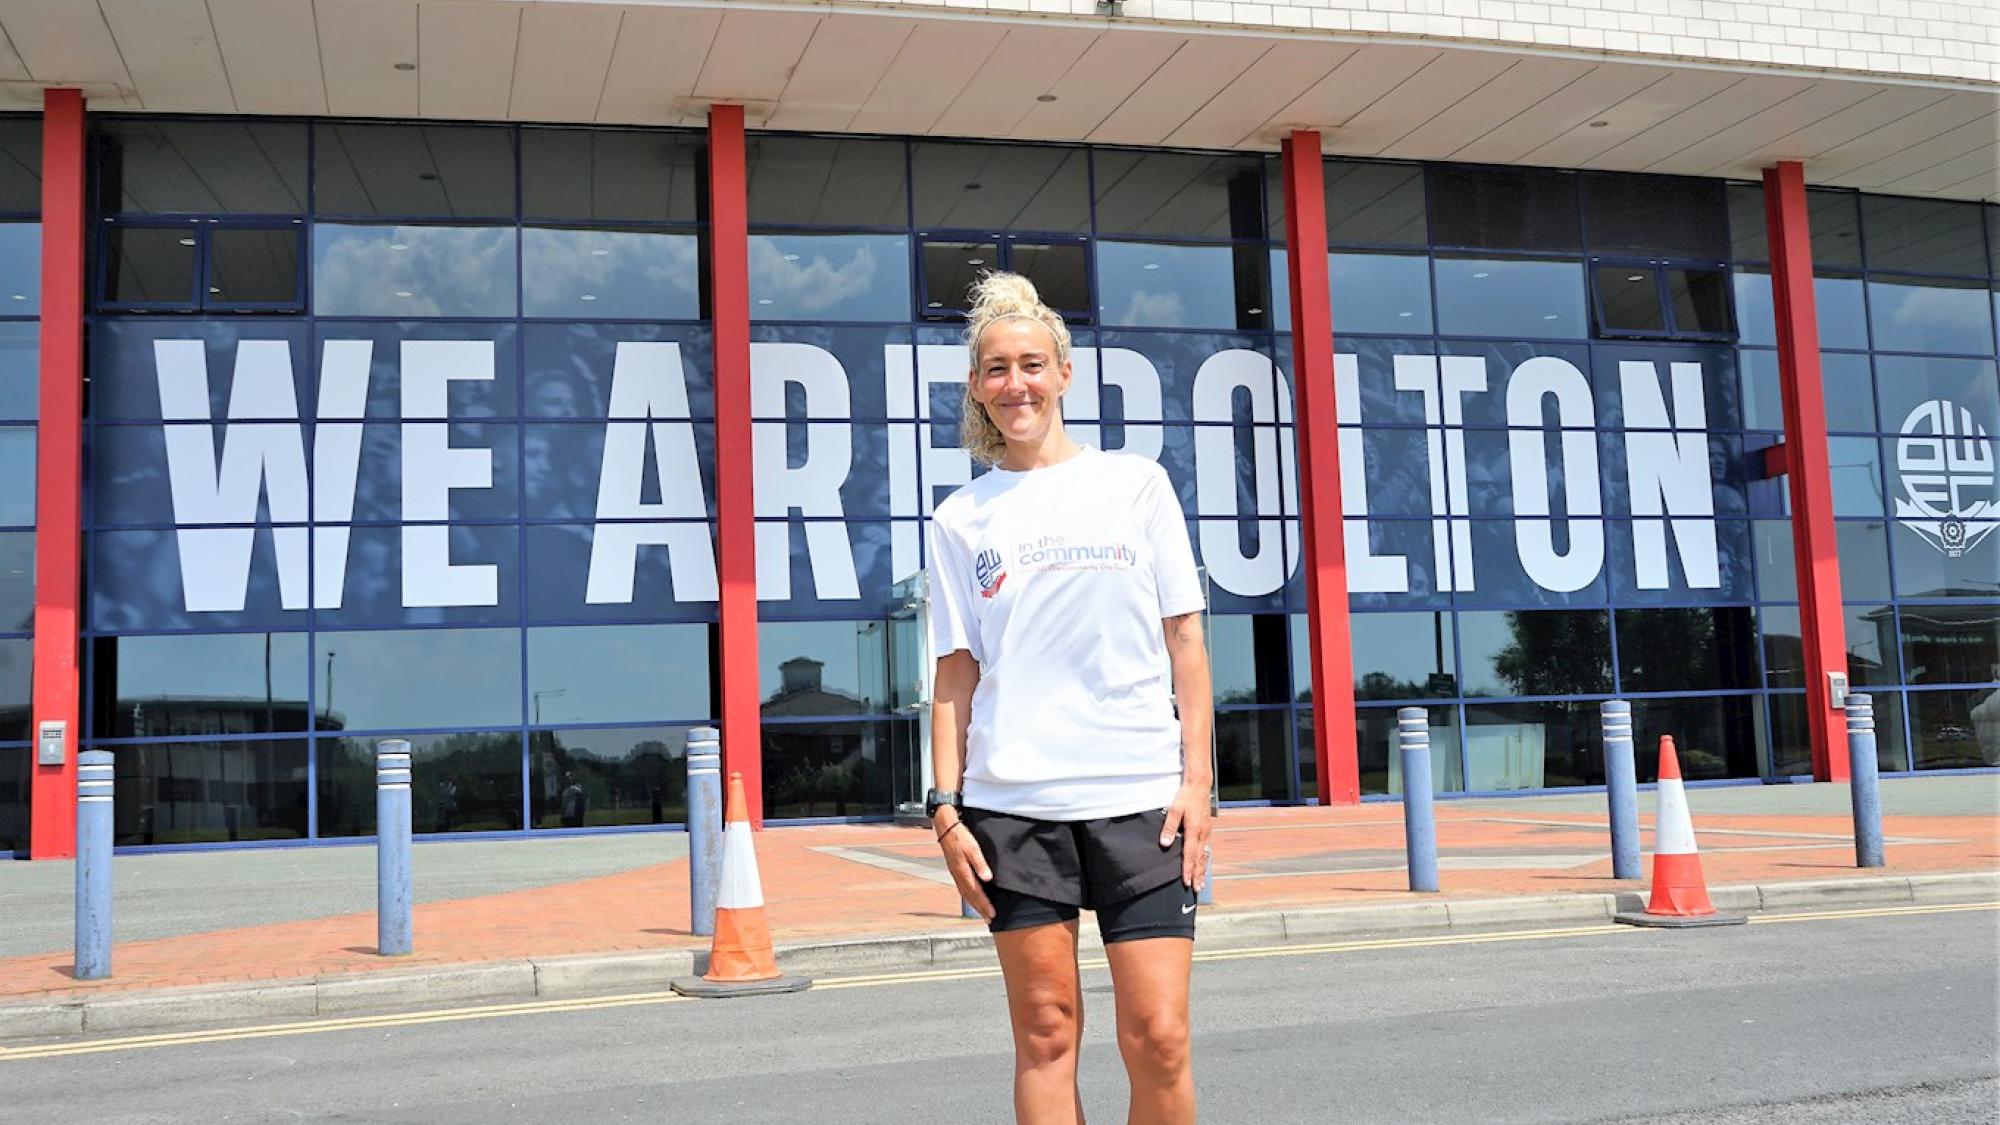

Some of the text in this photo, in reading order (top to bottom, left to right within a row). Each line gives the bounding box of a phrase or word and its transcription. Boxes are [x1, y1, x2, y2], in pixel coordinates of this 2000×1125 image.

[153, 339, 498, 612] WE
[1018, 535, 1065, 553] in the
[1019, 543, 1137, 567] community
